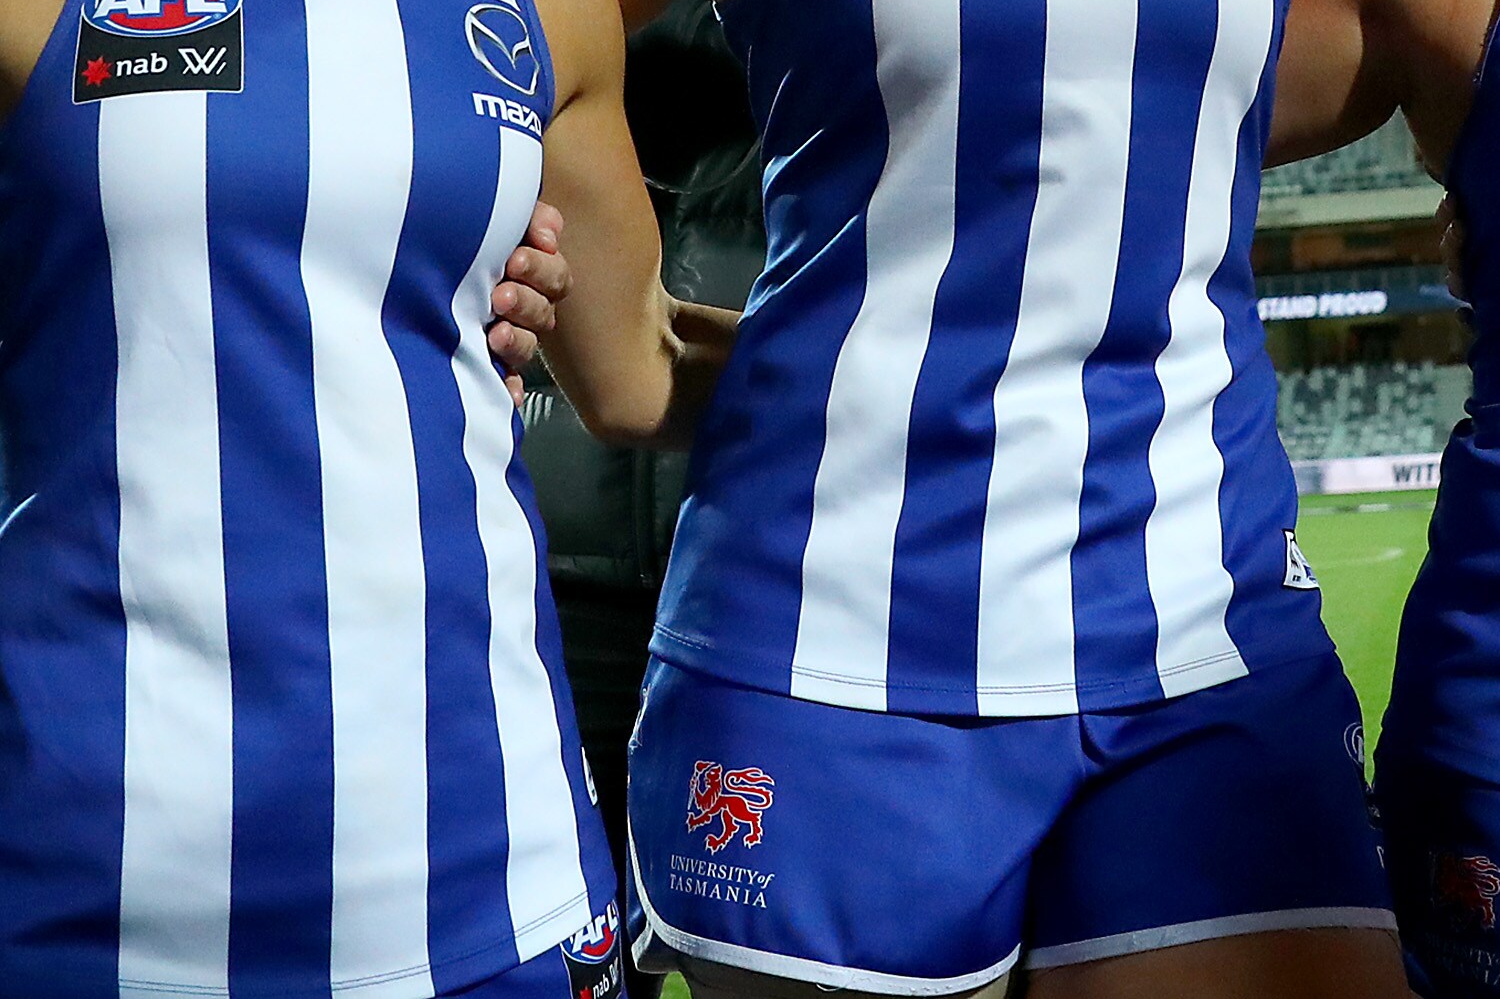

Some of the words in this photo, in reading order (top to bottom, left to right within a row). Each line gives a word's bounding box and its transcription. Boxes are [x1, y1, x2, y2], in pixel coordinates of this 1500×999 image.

[116, 52, 168, 77] nab
[472, 92, 542, 136] mazd
[670, 854, 759, 886] UNIVERSITY
[669, 873, 767, 909] TASMANIA
